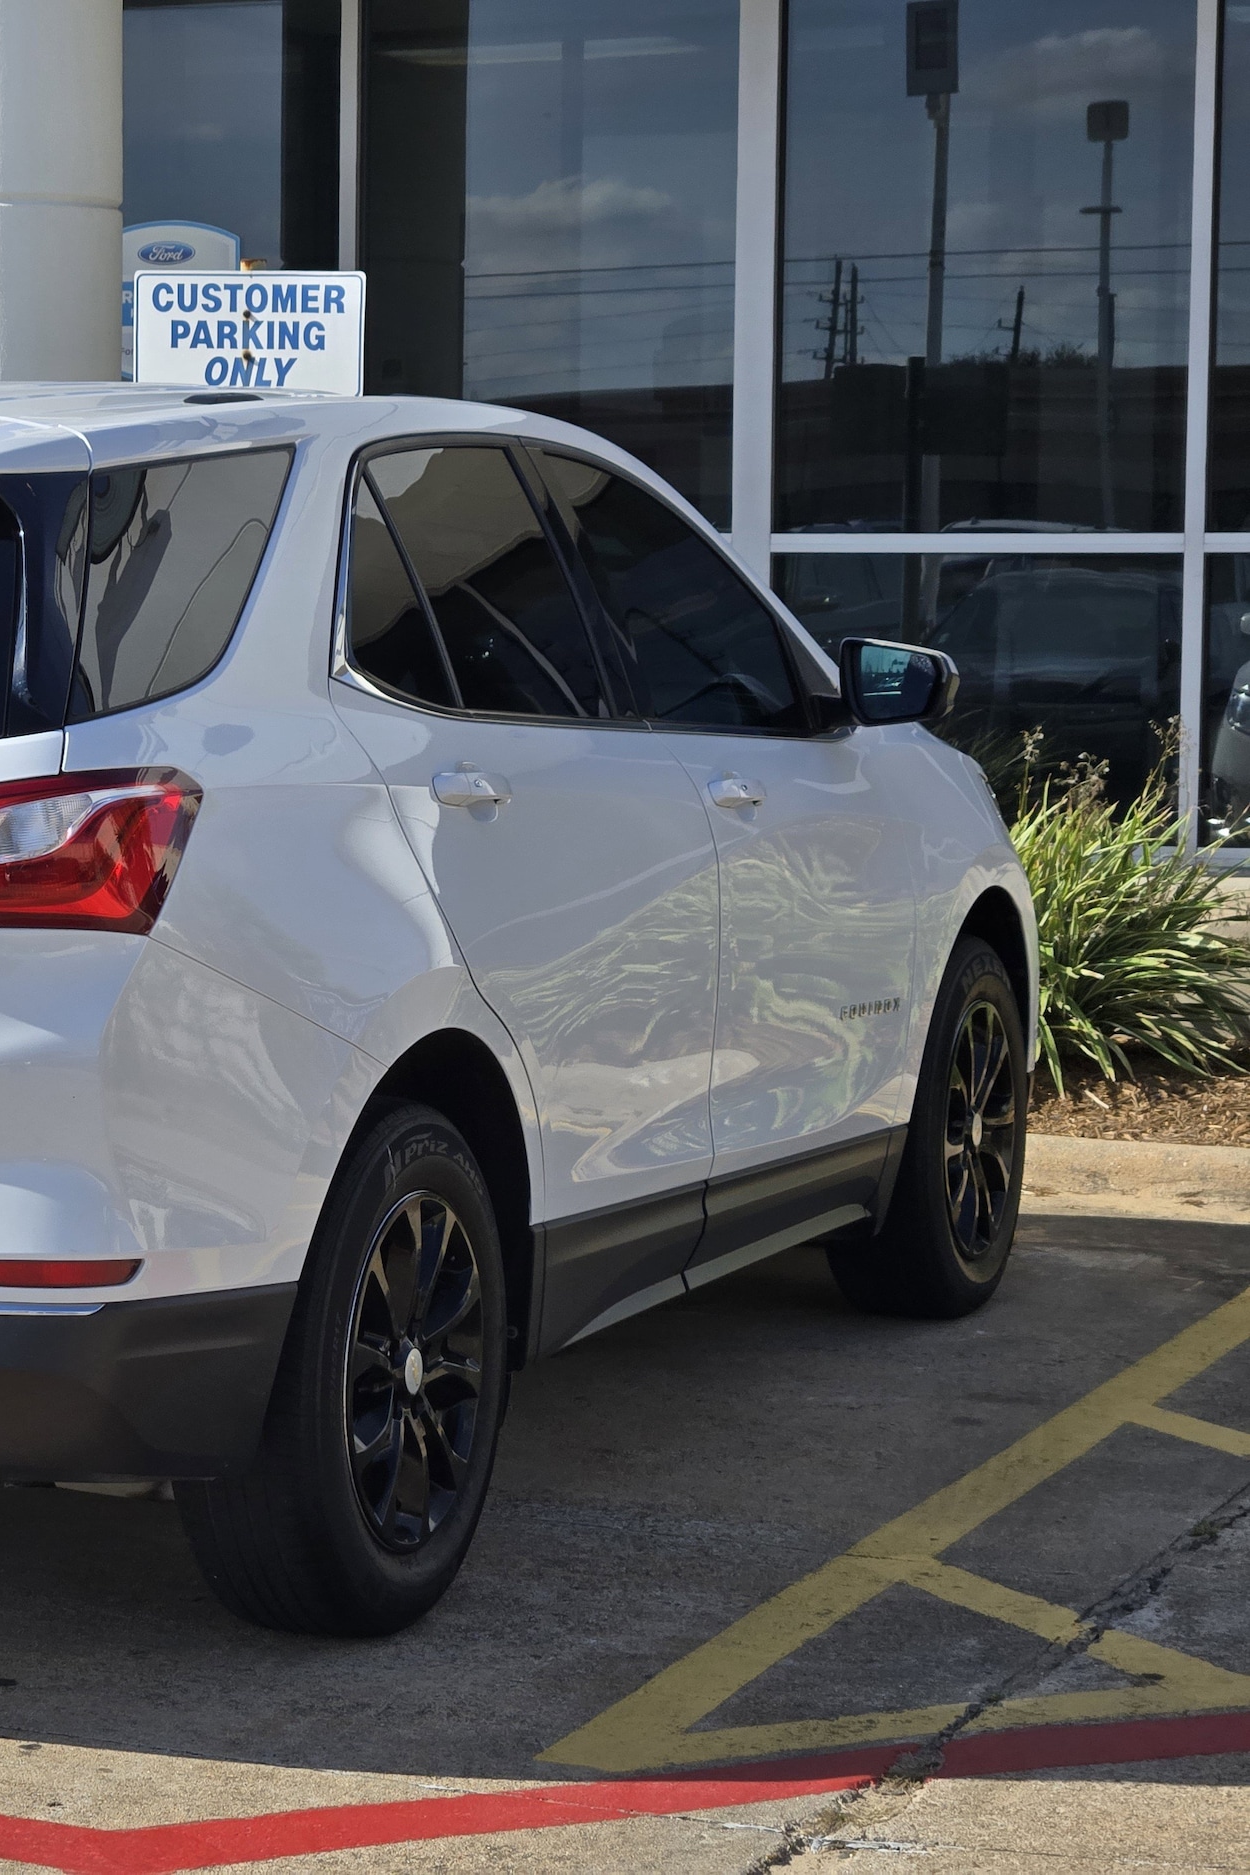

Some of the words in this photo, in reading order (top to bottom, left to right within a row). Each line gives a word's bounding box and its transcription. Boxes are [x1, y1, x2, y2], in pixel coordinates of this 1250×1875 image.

[148, 244, 184, 261] Ford
[152, 282, 346, 313] CUSTOMER
[170, 320, 325, 351] PARKING
[204, 356, 298, 387] ONLY
